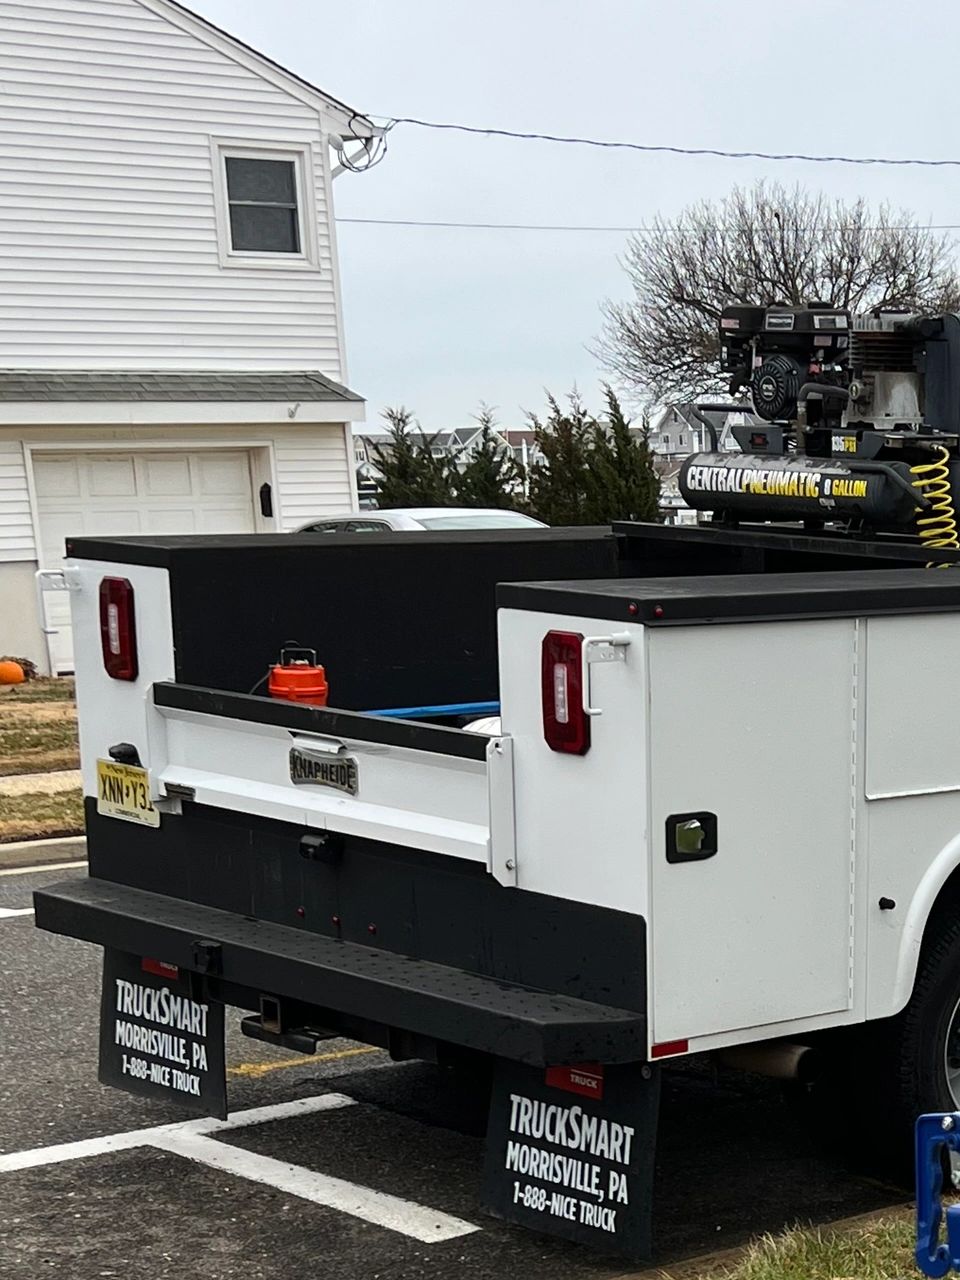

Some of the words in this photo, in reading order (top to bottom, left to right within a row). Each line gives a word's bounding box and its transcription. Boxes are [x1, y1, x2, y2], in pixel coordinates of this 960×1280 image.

[832, 479, 868, 497] GALLON
[292, 752, 354, 789] KNAPHEIDE
[115, 1019, 190, 1070] MORRISVILLE,
[192, 1042, 208, 1072] PA
[122, 1054, 170, 1087] 1-888-NICE
[172, 1069, 201, 1097] TRUCK
[570, 1073, 598, 1089] TRUCK
[505, 1140, 604, 1202] MORRISVILLE,
[608, 1169, 629, 1205] PA
[513, 1181, 576, 1221] 1-888-NICE
[579, 1200, 617, 1233] TRUCK
